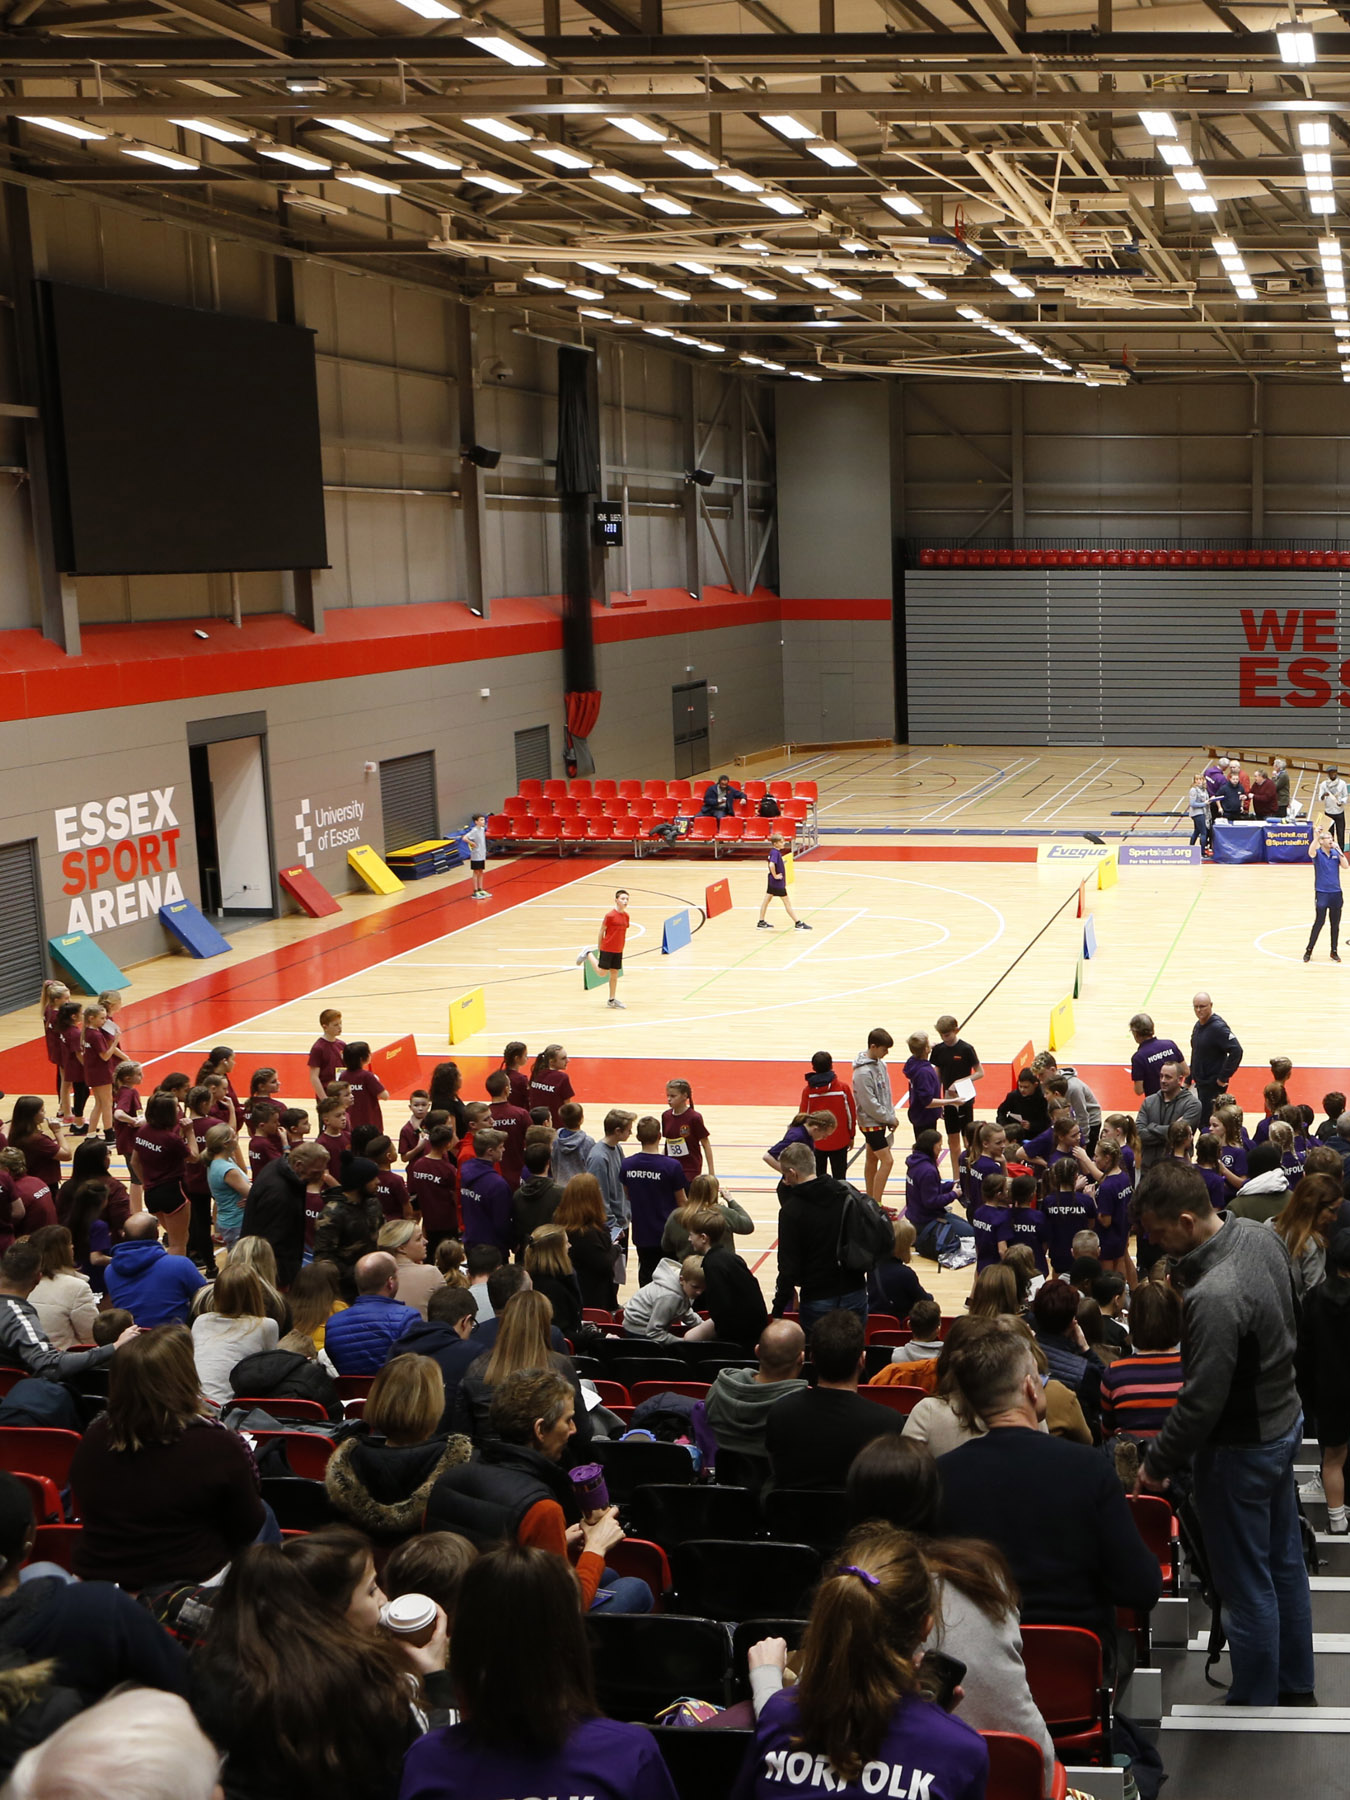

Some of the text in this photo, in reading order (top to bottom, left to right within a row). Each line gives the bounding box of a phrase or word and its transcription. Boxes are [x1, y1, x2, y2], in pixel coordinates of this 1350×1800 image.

[1239, 609, 1338, 653] WE
[54, 786, 179, 852] ESSEX
[315, 799, 364, 828] University
[318, 827, 361, 851] of Essex
[1047, 845, 1109, 859] Eveque
[61, 828, 180, 896] SPORT
[66, 871, 185, 935] ARENA
[1147, 1048, 1175, 1063] NORFOLK
[531, 1081, 555, 1092] UFFOLK
[135, 1136, 162, 1153] SUFFOLK
[671, 1144, 683, 1155] 58
[626, 1170, 661, 1180] NORFOLK
[1284, 1164, 1305, 1176] RFOLK
[972, 1219, 993, 1232] ORFOLK
[764, 1750, 936, 1800] NOROLK
